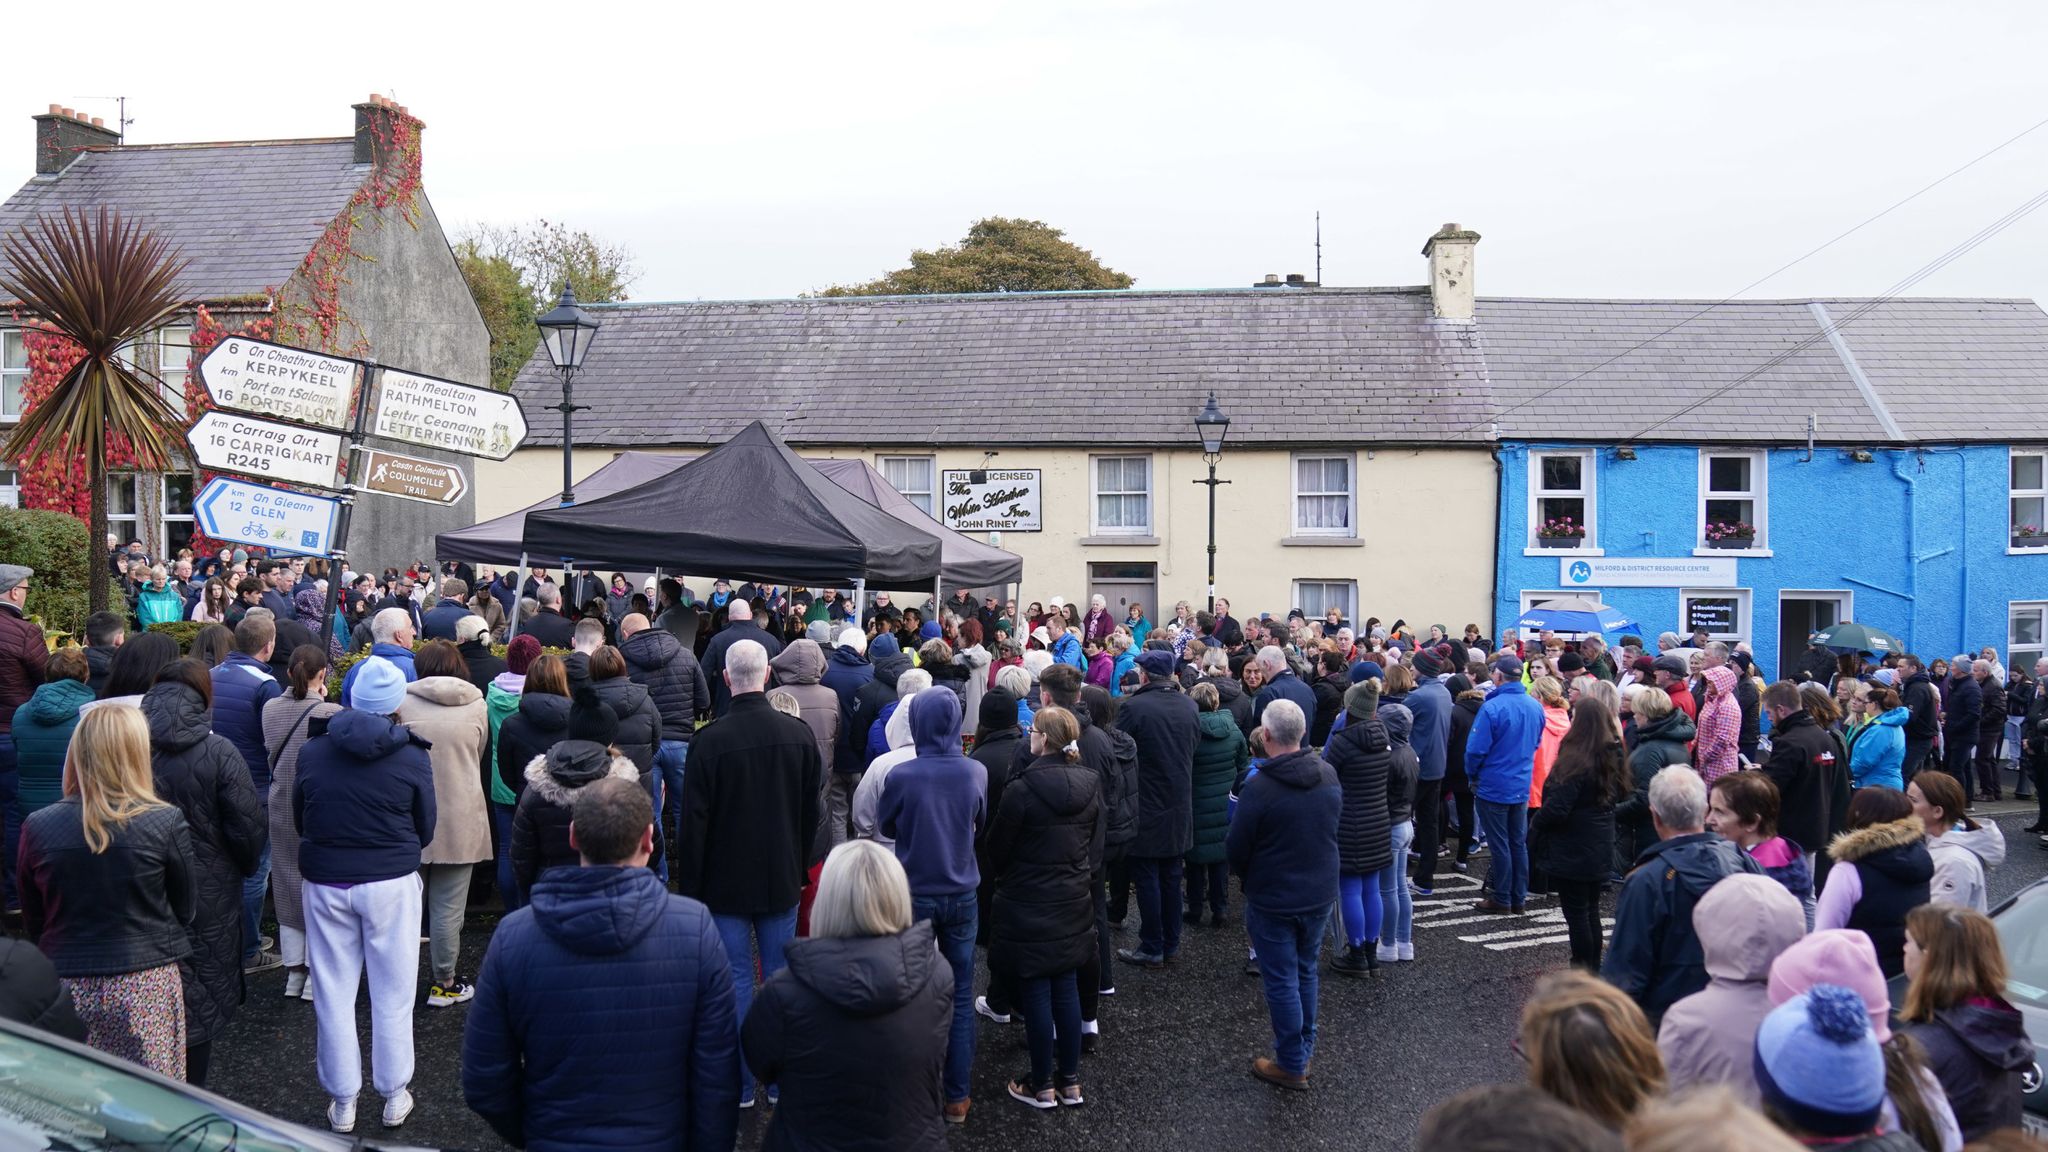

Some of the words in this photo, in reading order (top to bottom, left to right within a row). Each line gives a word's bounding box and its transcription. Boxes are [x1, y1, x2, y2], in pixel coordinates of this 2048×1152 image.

[228, 342, 240, 354] 6
[249, 346, 264, 358] An
[318, 360, 348, 374] Chaol
[220, 366, 238, 376] km
[243, 378, 269, 392] Port
[270, 386, 286, 396] an
[388, 378, 418, 390] ath
[422, 382, 476, 402] Mealtain
[218, 388, 234, 401] 16
[240, 393, 336, 421] PORTSALON
[386, 389, 477, 416] RATHMELTON
[502, 400, 510, 410] 7
[210, 418, 228, 428] km
[383, 406, 419, 422] Leitir
[424, 414, 486, 437] Ceanainn
[493, 422, 508, 432] km
[210, 434, 226, 446] 16
[232, 423, 286, 444] Carraig
[292, 434, 320, 448] Airt
[380, 420, 485, 450] LETTERKENNY
[230, 438, 332, 466] CARRIGKART
[226, 452, 270, 470] R245
[389, 471, 444, 488] COLUMCILLE
[950, 472, 970, 480] FUL
[986, 472, 1034, 480] ICENSED
[232, 488, 245, 498] km
[404, 485, 428, 496] TRAIL
[947, 482, 972, 496] The
[229, 502, 242, 512] 12
[253, 493, 269, 504] An
[274, 497, 314, 512] Gleann
[947, 497, 982, 520] White
[983, 487, 1030, 509] Heather
[251, 506, 286, 520] GLEN
[1001, 504, 1031, 518] Inn
[954, 520, 983, 528] JOHN
[986, 520, 1018, 528] RINEY
